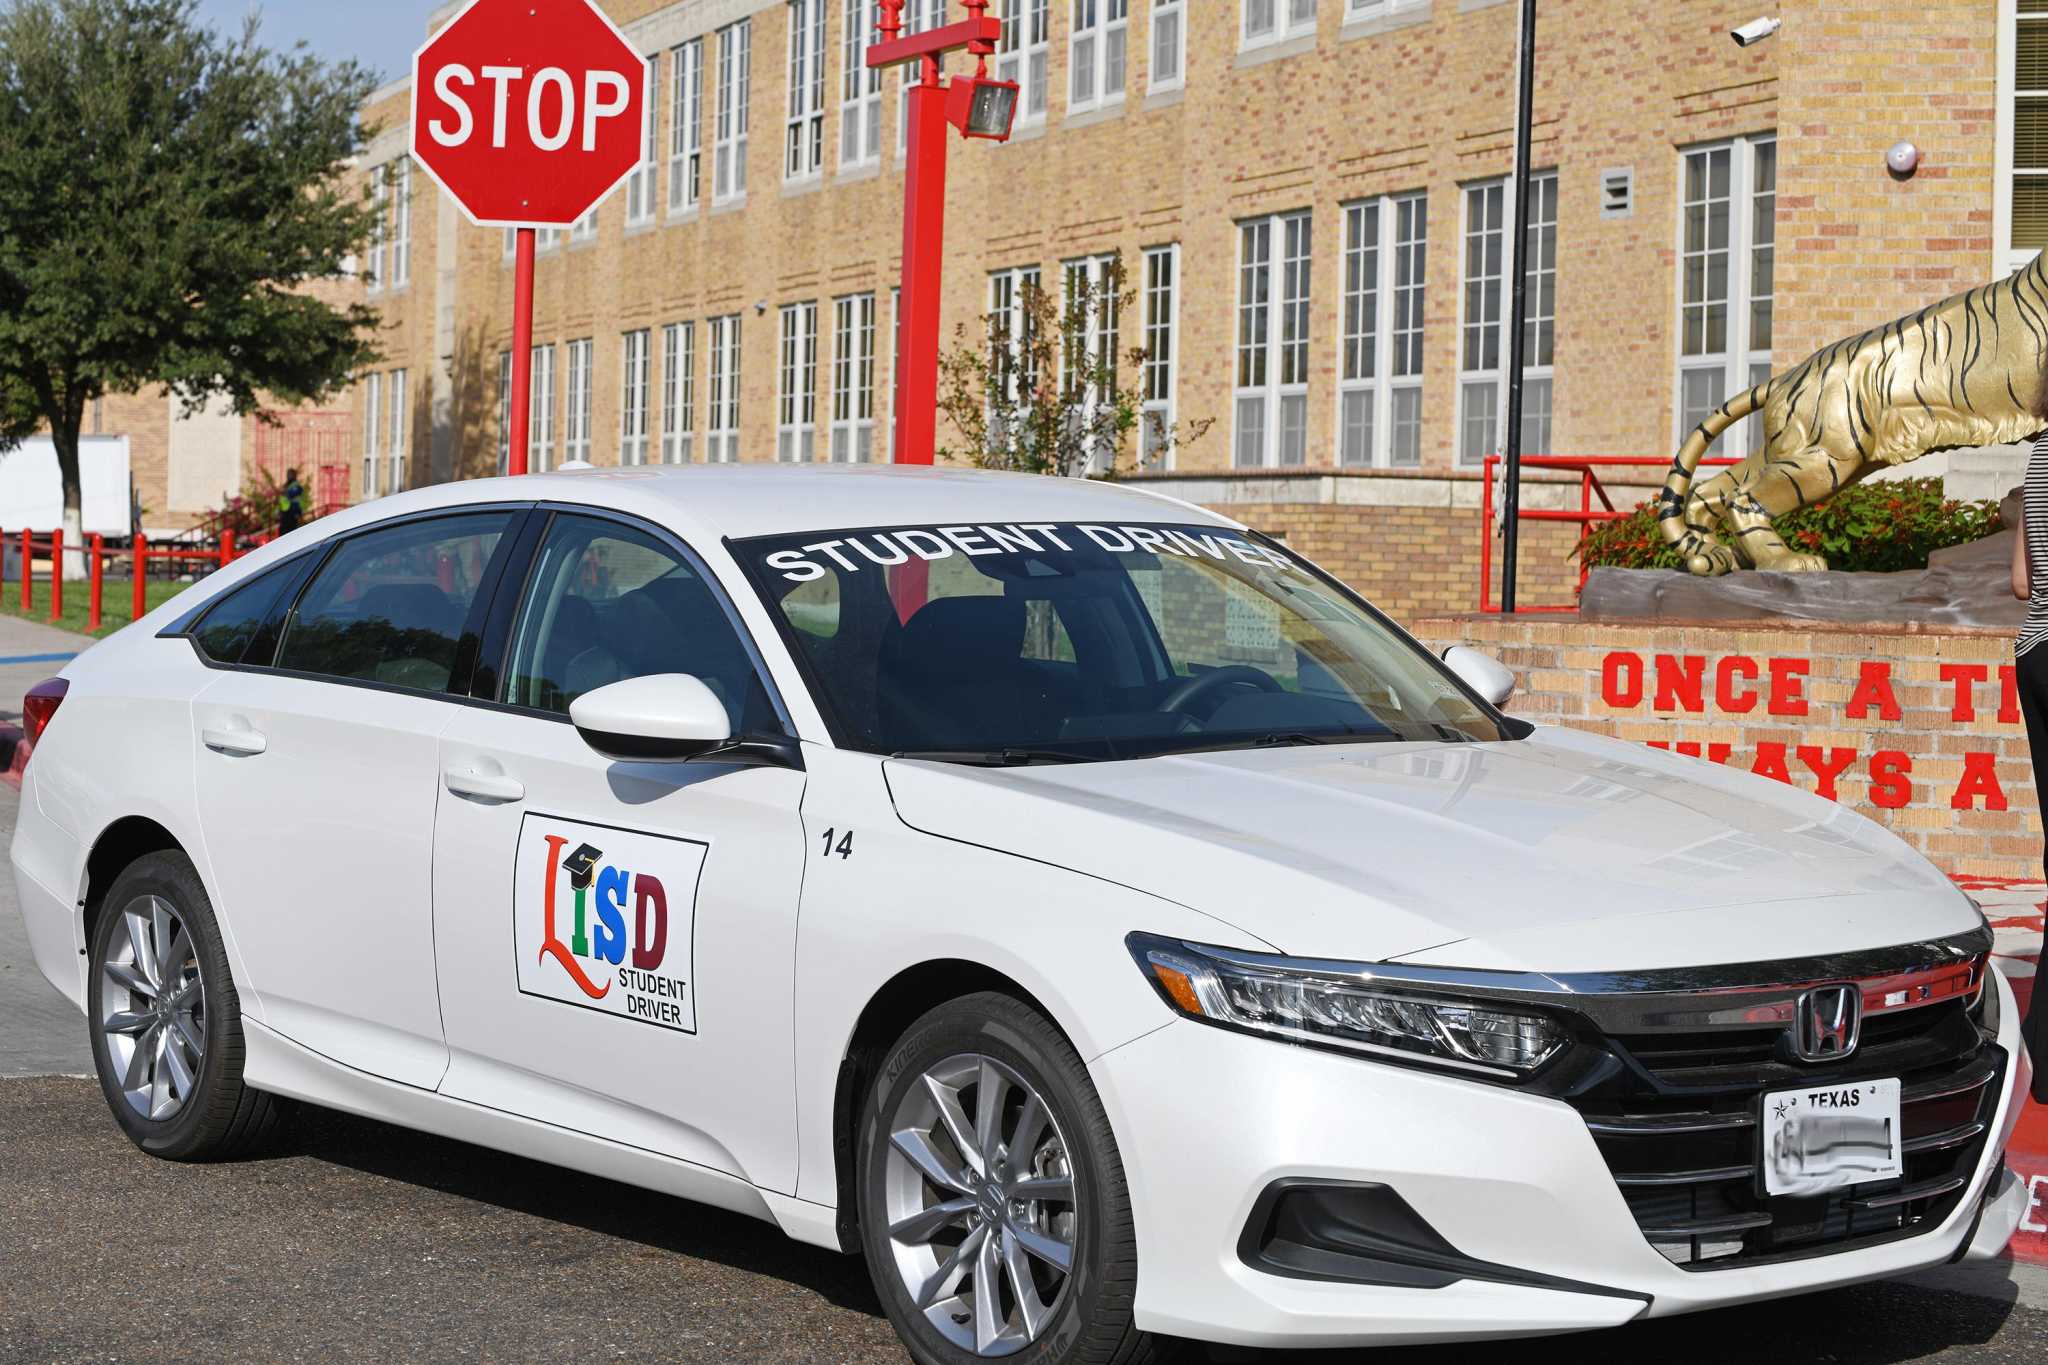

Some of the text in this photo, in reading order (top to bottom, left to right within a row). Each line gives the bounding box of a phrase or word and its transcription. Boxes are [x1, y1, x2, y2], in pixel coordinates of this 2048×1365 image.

[428, 63, 630, 151] STOP
[766, 524, 1313, 582] STUDENT DRIVER
[1602, 651, 1810, 716] ONCE
[1846, 662, 1902, 720] A
[1951, 752, 2008, 811] A
[822, 827, 854, 860] 14
[539, 835, 668, 999] LISD
[619, 967, 686, 1001] STUDENT
[627, 994, 682, 1025] DRIVER
[1808, 1088, 1860, 1109] TEXAS
